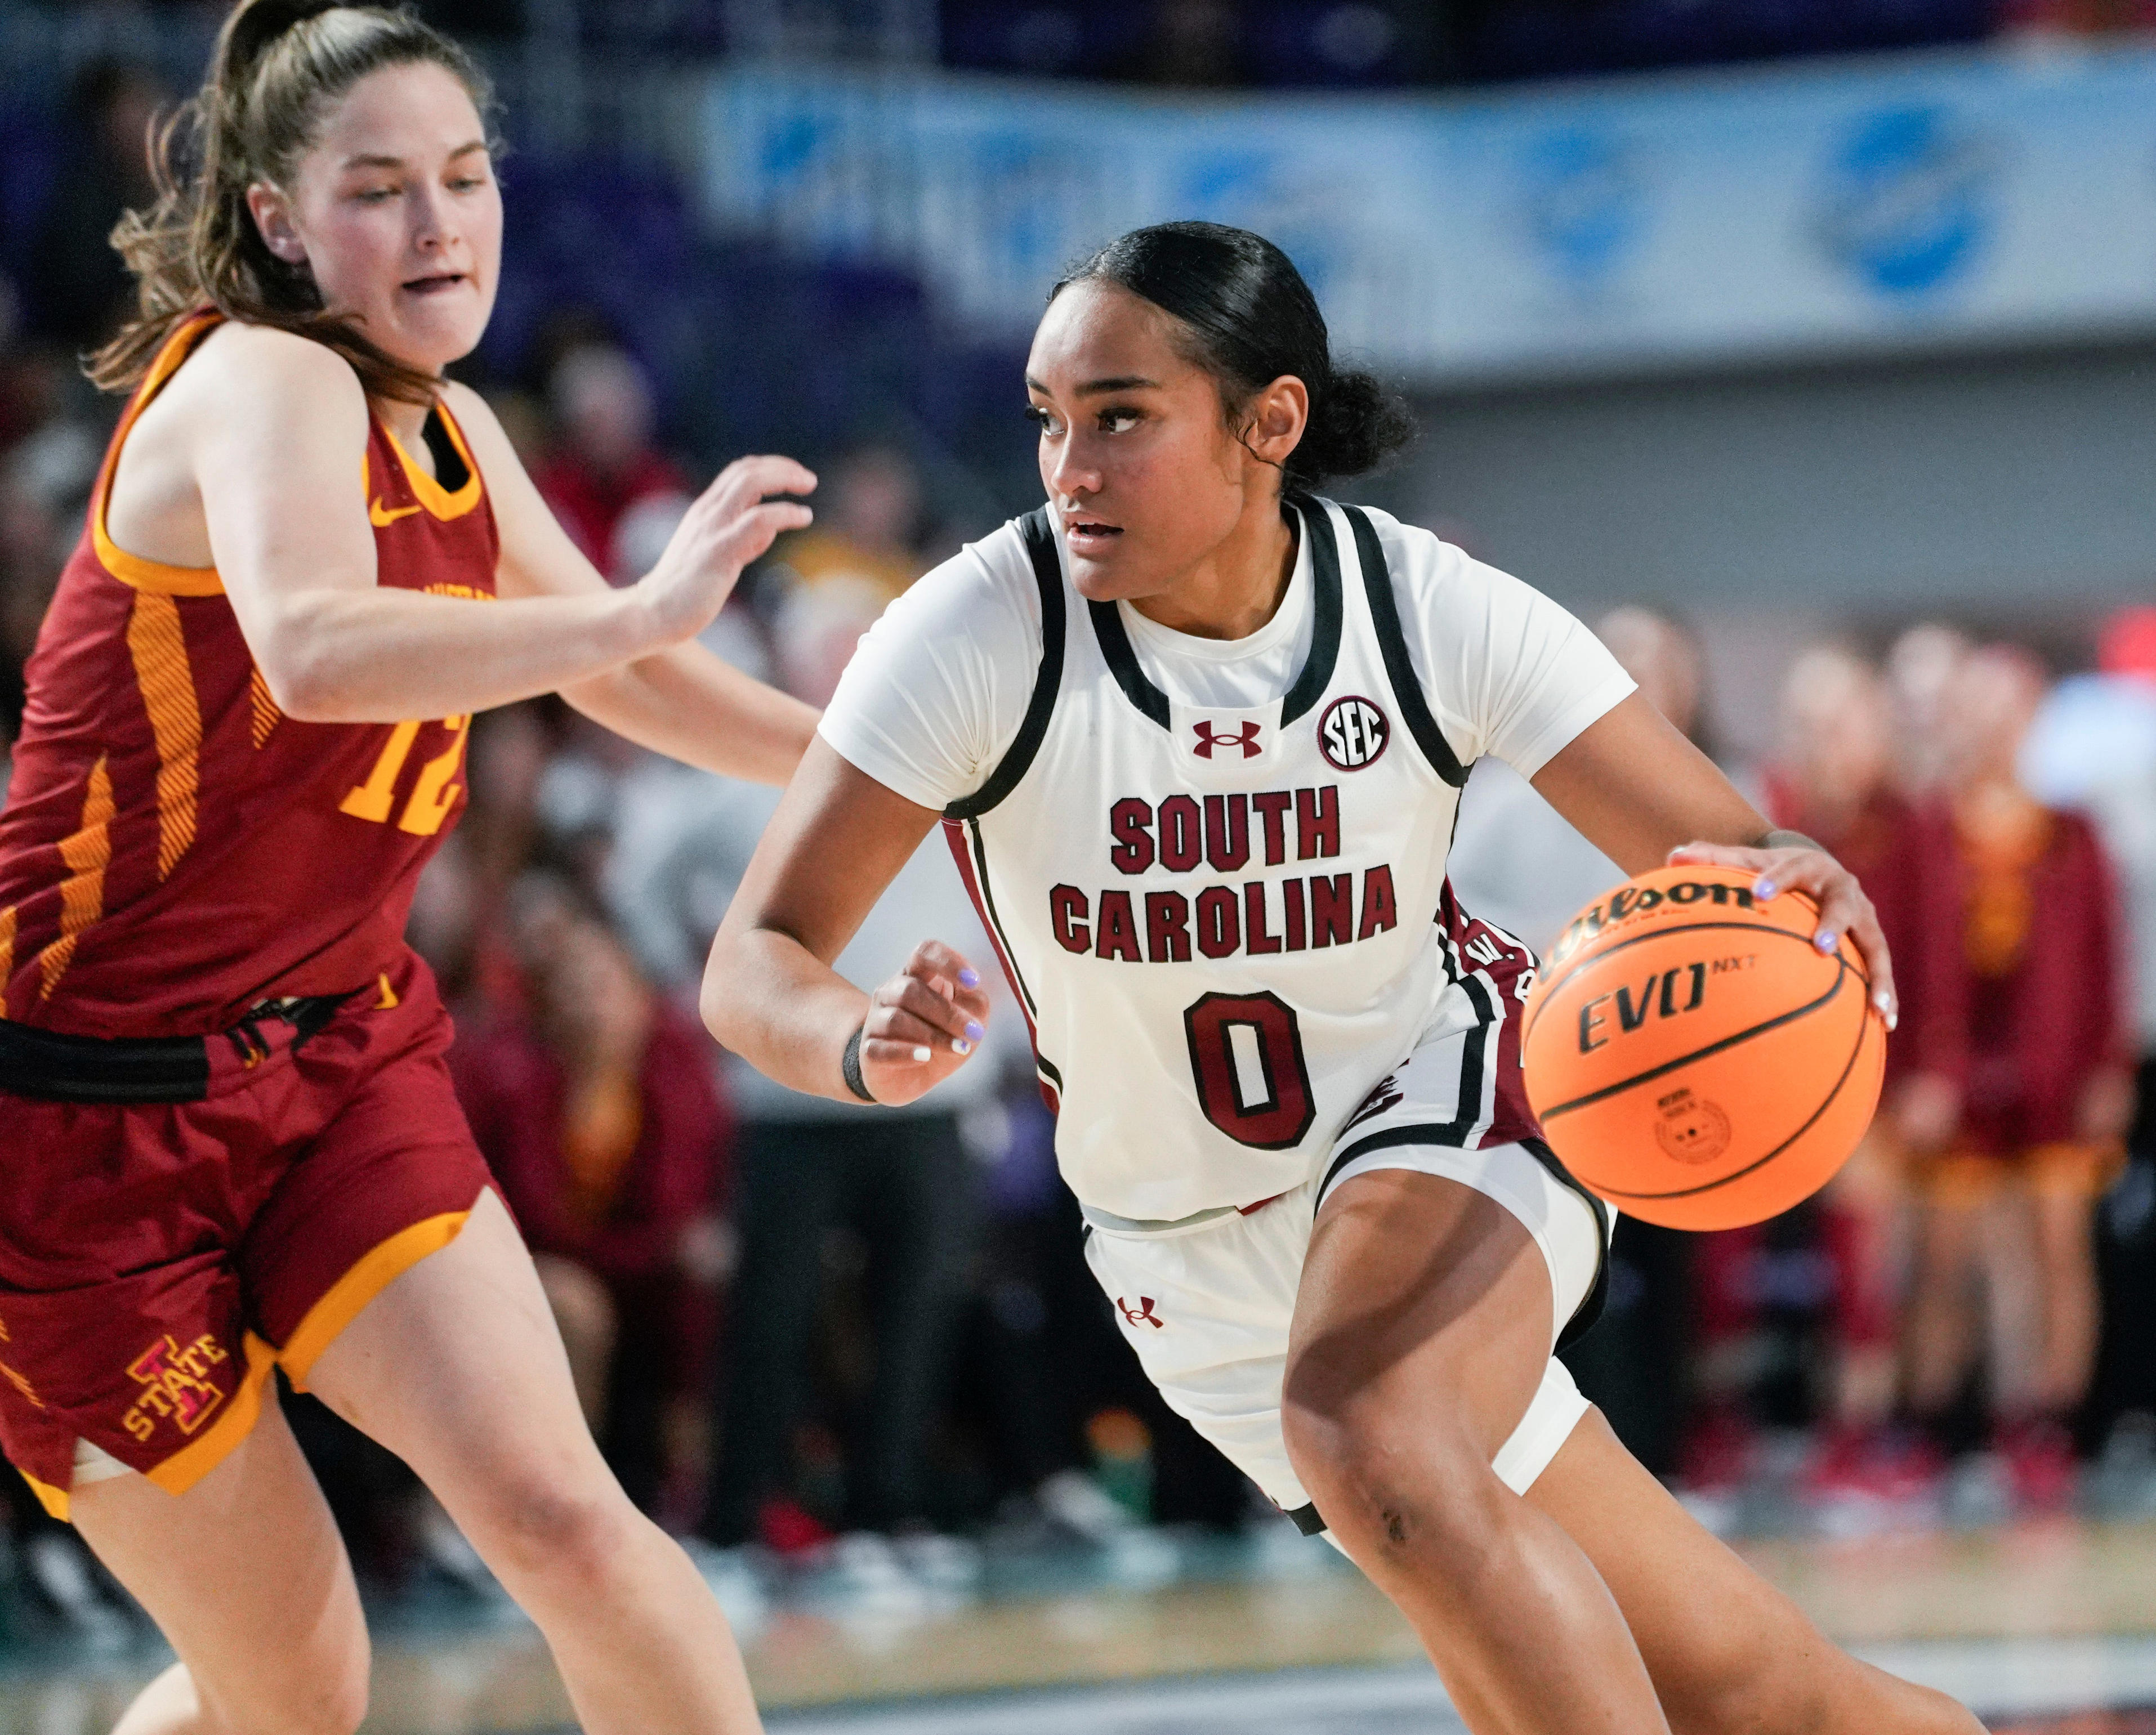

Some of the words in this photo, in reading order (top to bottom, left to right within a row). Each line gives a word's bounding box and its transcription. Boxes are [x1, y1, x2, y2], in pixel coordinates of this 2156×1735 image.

[1324, 701, 1383, 766] SEC
[1110, 785, 1341, 875] SOUTH
[1049, 864, 1398, 963] CAROLINA
[1578, 962, 1706, 1055] EVO
[1185, 991, 1316, 1151] 0
[122, 1333, 229, 1442] STATE
